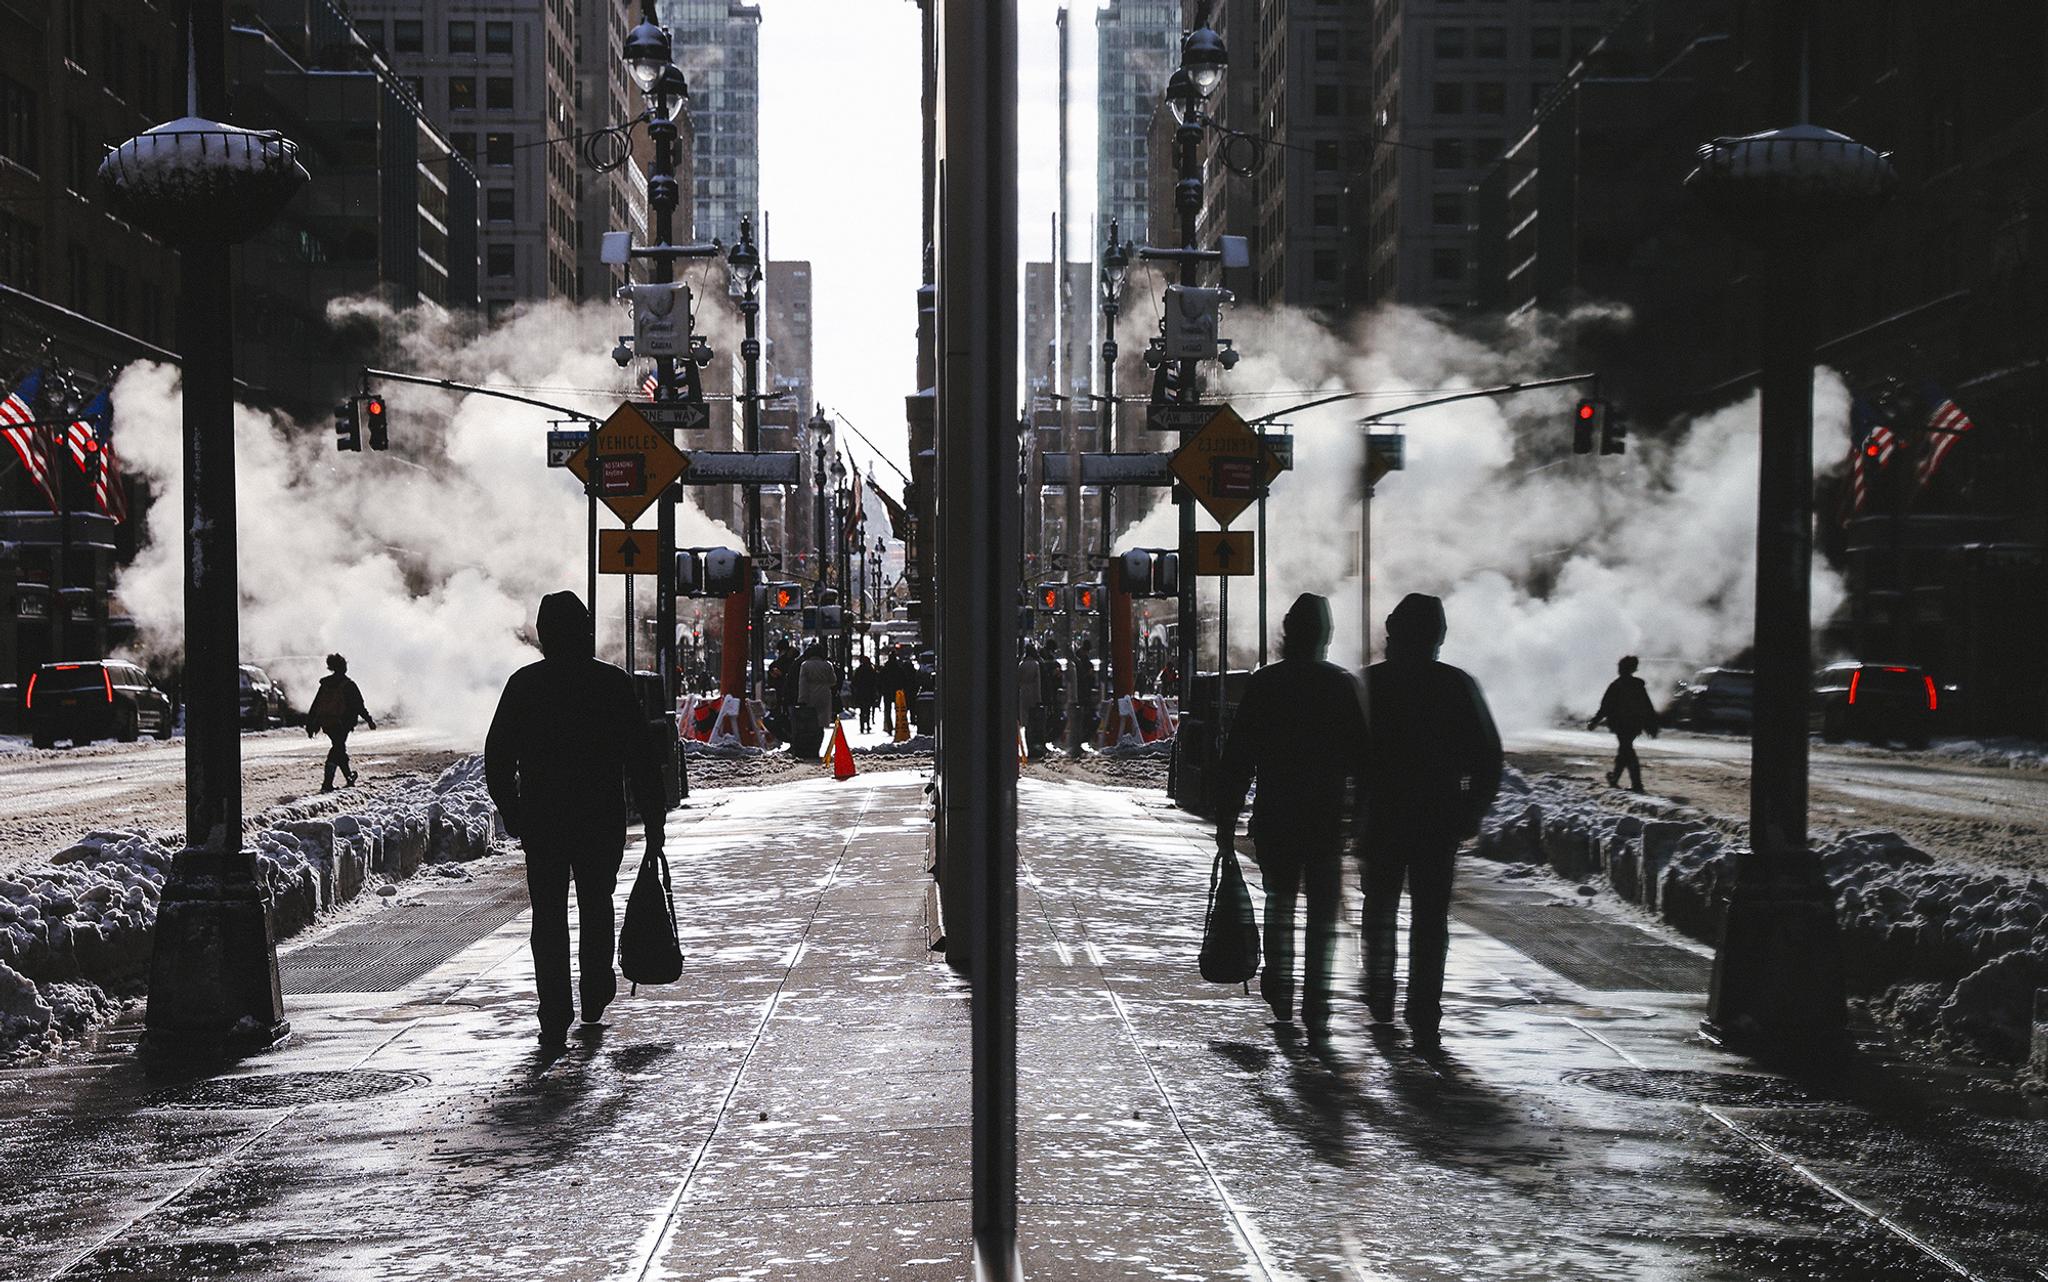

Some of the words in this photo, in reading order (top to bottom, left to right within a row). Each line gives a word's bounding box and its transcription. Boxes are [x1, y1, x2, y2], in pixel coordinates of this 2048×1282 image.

[643, 409, 664, 422] ONE
[673, 410, 697, 422] WAY
[600, 435, 658, 449] VEHICLES
[758, 557, 775, 567] WAY
